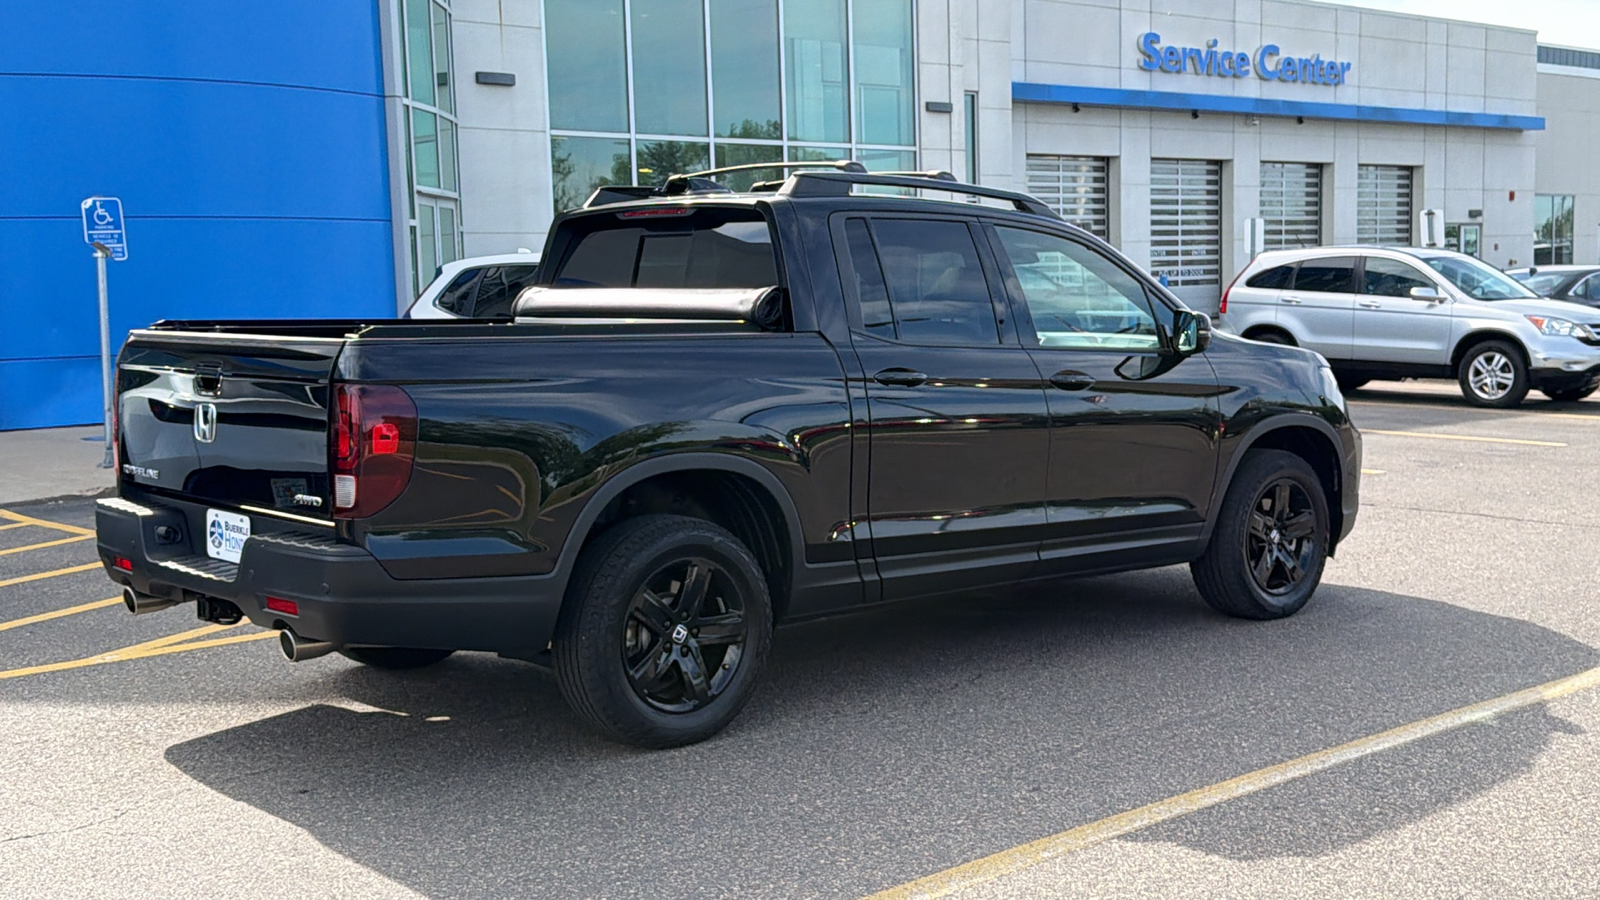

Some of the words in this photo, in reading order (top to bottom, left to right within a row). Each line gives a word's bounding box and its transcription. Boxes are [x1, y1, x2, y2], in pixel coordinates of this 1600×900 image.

[1138, 32, 1250, 78] Service
[1254, 44, 1351, 86] Center
[224, 520, 249, 537] BUERKLE
